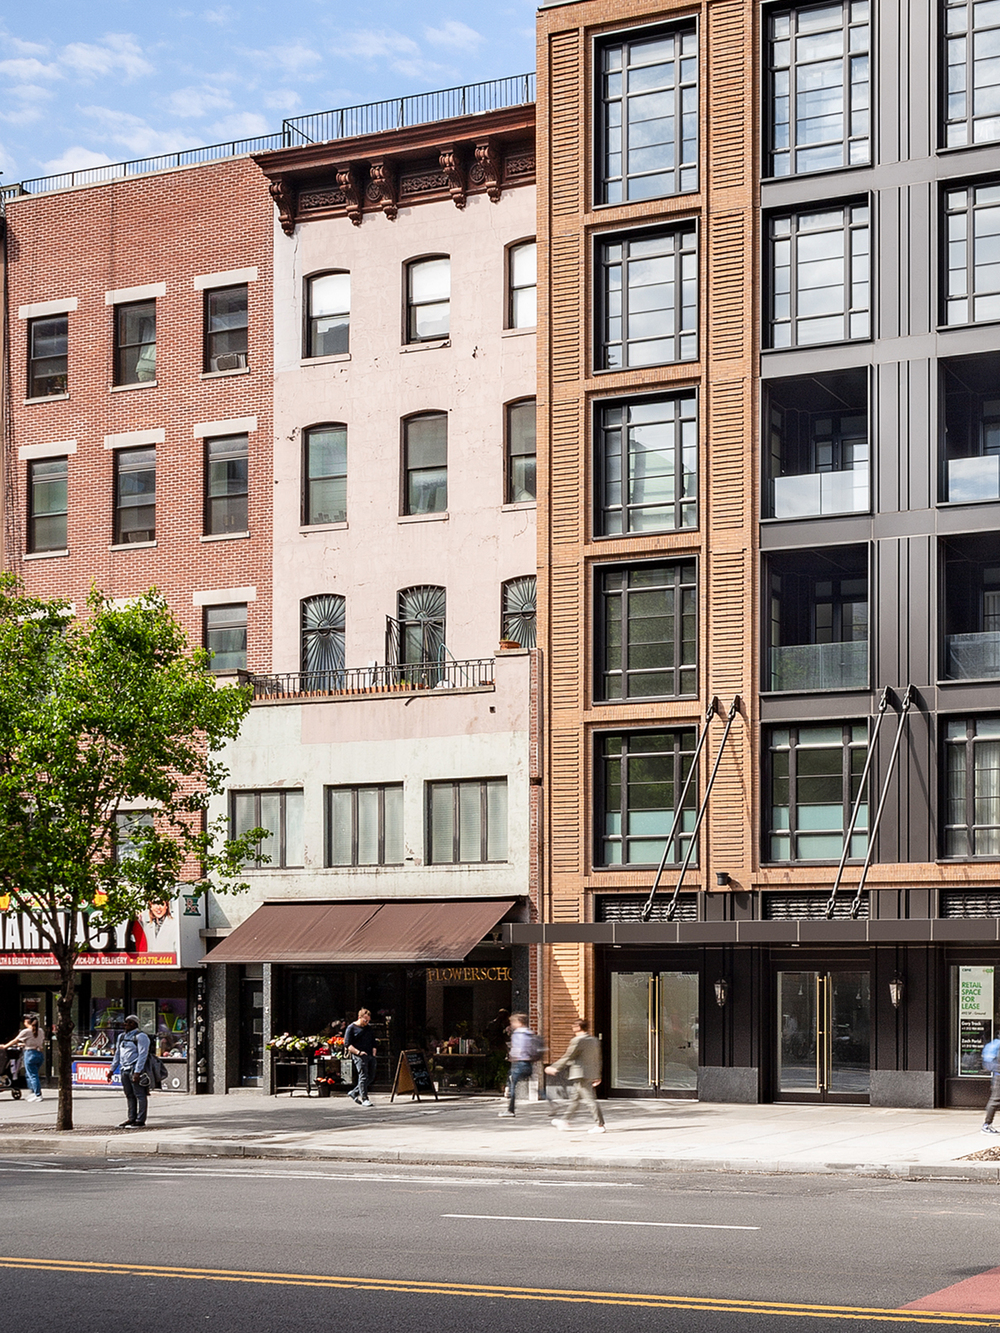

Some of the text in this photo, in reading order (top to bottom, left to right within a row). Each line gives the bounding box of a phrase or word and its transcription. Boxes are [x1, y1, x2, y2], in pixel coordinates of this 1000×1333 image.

[12, 956, 29, 965] BEAUTY
[30, 956, 54, 965] PRODUCTS
[101, 956, 127, 965] DELIVERY
[78, 1067, 110, 1081] PHARMAC
